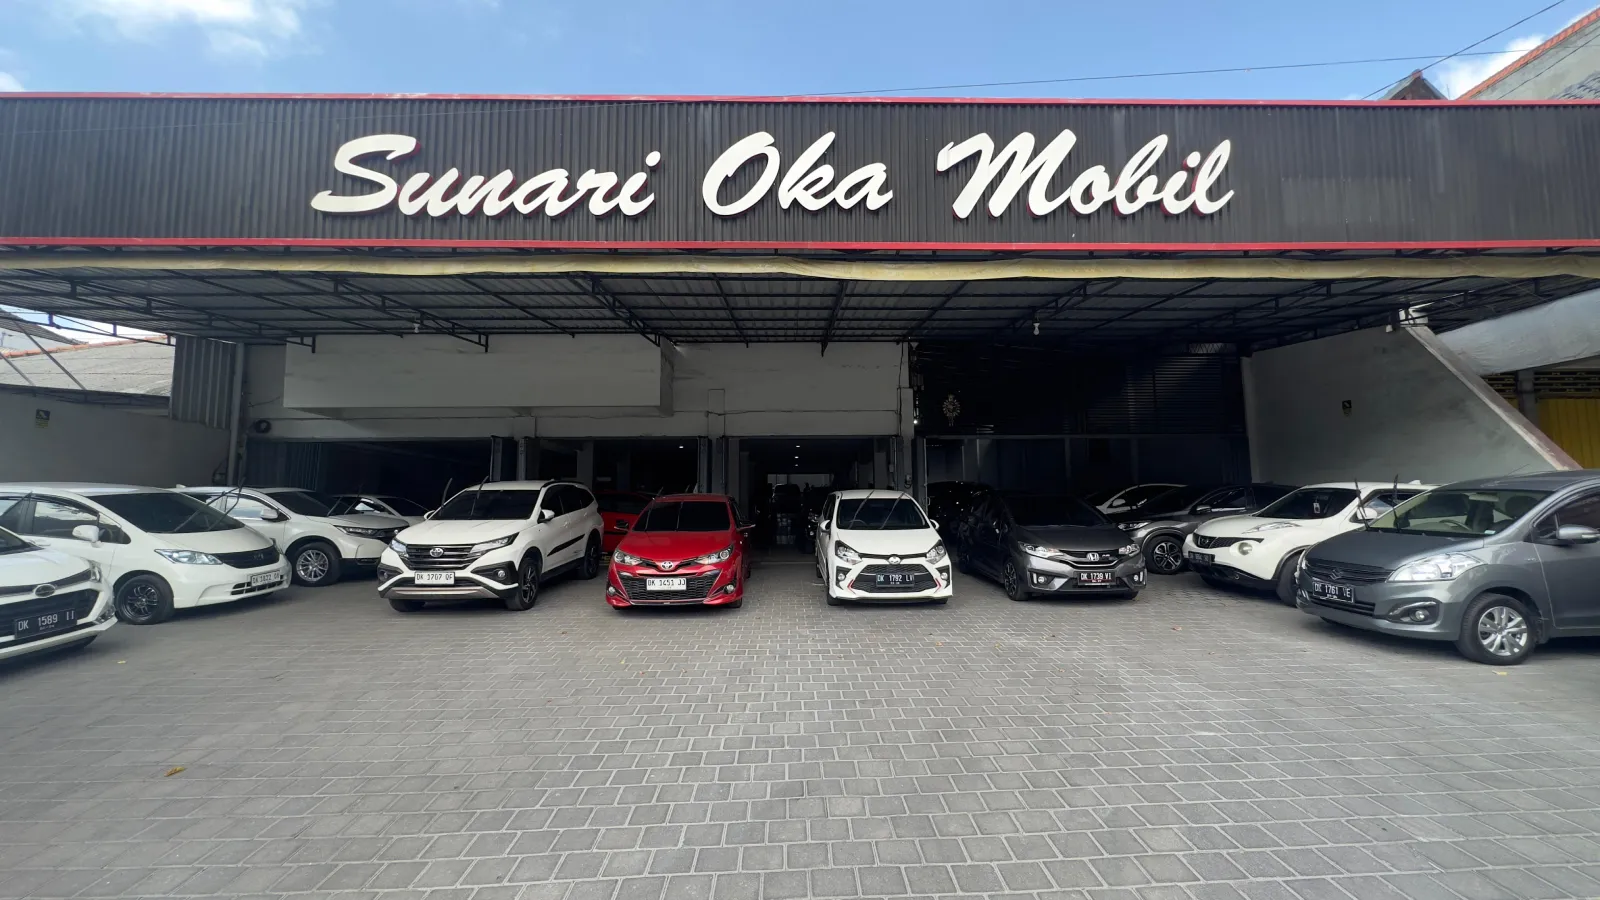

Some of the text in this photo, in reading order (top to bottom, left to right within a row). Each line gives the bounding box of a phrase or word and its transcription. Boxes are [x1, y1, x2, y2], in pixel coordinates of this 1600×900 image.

[310, 128, 1235, 219] Sunari Oka Mobil
[416, 573, 424, 581] DK
[877, 574, 885, 582] DK
[889, 574, 903, 582] 1792
[1080, 572, 1088, 580] DK
[1090, 572, 1103, 580] 1739
[659, 579, 674, 587] 1451
[1314, 583, 1322, 592] DK
[1325, 584, 1338, 595] 1761
[18, 619, 29, 631] DK
[38, 613, 58, 627] 1589
